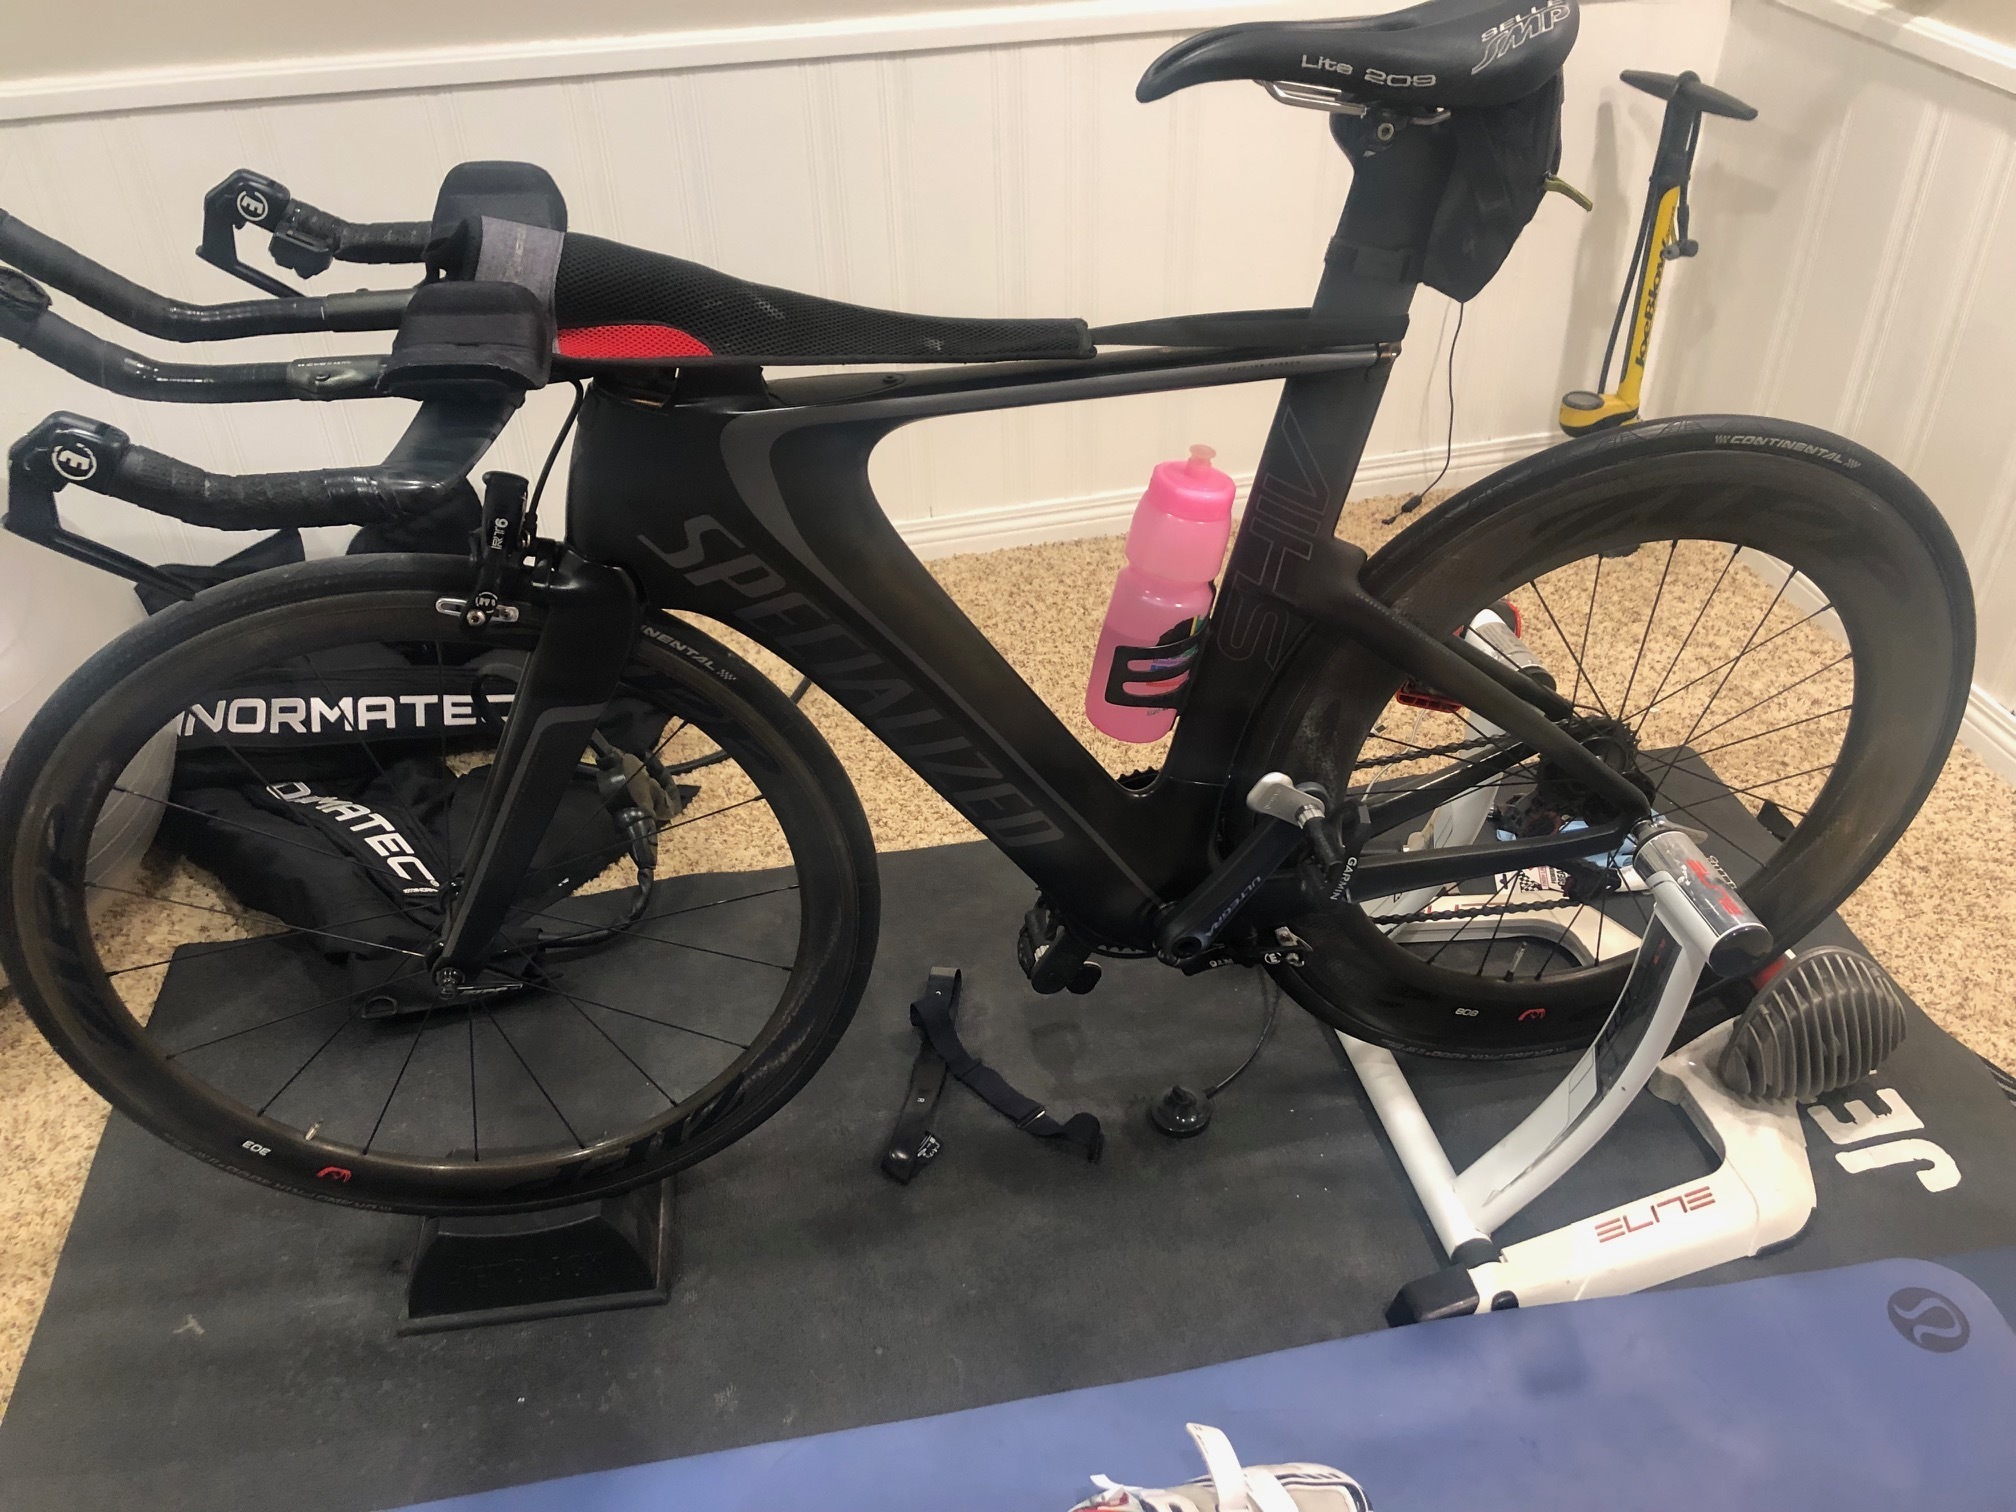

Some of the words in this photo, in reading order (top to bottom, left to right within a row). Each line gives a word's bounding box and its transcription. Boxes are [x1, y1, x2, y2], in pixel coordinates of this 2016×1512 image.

[1471, 4, 1571, 76] SMP
[1481, 0, 1564, 42] SELLE
[1301, 54, 1354, 76] Lite
[1364, 68, 1437, 88] 209
[1729, 434, 1844, 464] CONTINENTAL
[491, 517, 509, 550] RT6
[1217, 405, 1331, 672] SHIV
[637, 513, 1065, 848] SPECIALIZED
[1204, 875, 1262, 937] ULTEGRA
[1329, 856, 1358, 901] GARMIN
[1807, 1088, 1962, 1193] JE
[1594, 1185, 1716, 1244] ELITE
